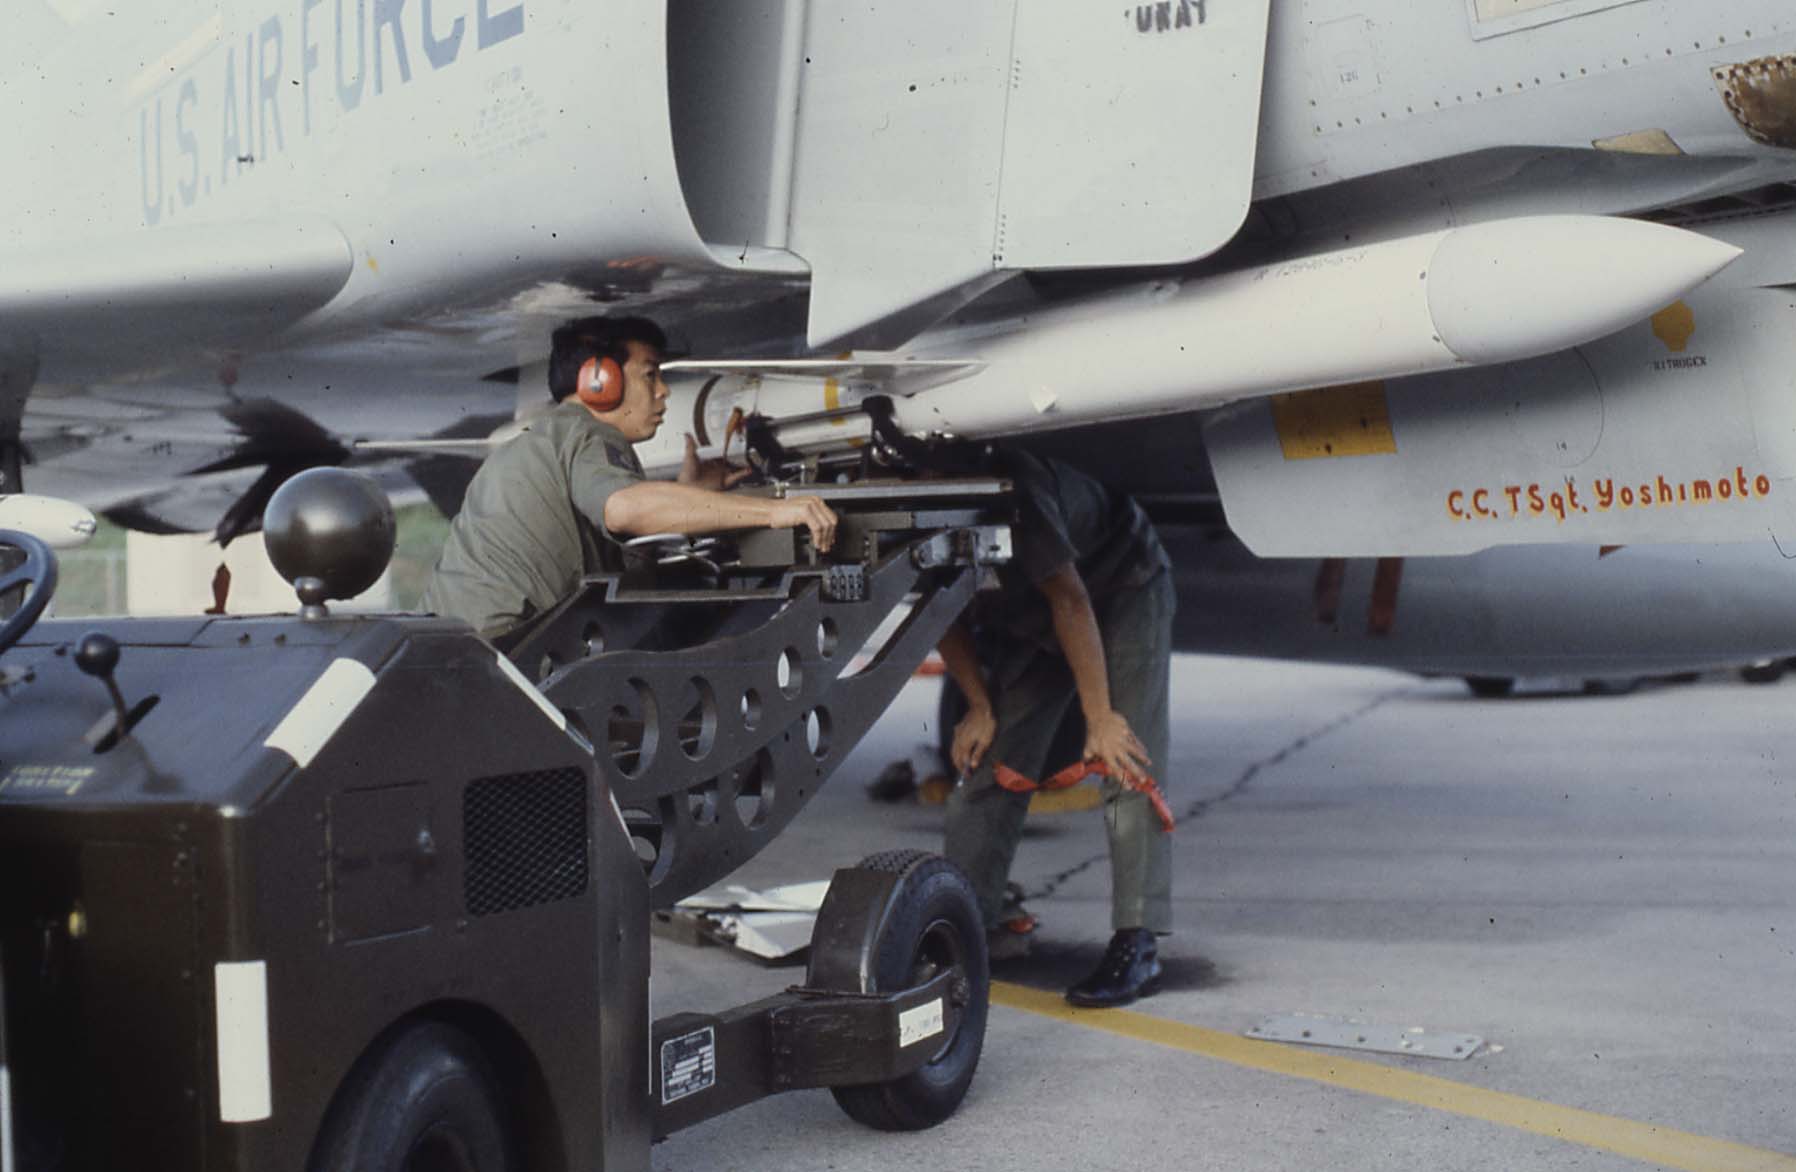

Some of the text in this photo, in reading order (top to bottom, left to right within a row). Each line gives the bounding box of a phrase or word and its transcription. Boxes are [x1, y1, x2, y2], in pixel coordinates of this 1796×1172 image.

[140, 78, 210, 226] U.S.
[222, 14, 284, 185] AIR
[302, 0, 525, 136] FOR
[1447, 488, 1499, 520] C.C.
[1593, 466, 1771, 508] Yoshimoto
